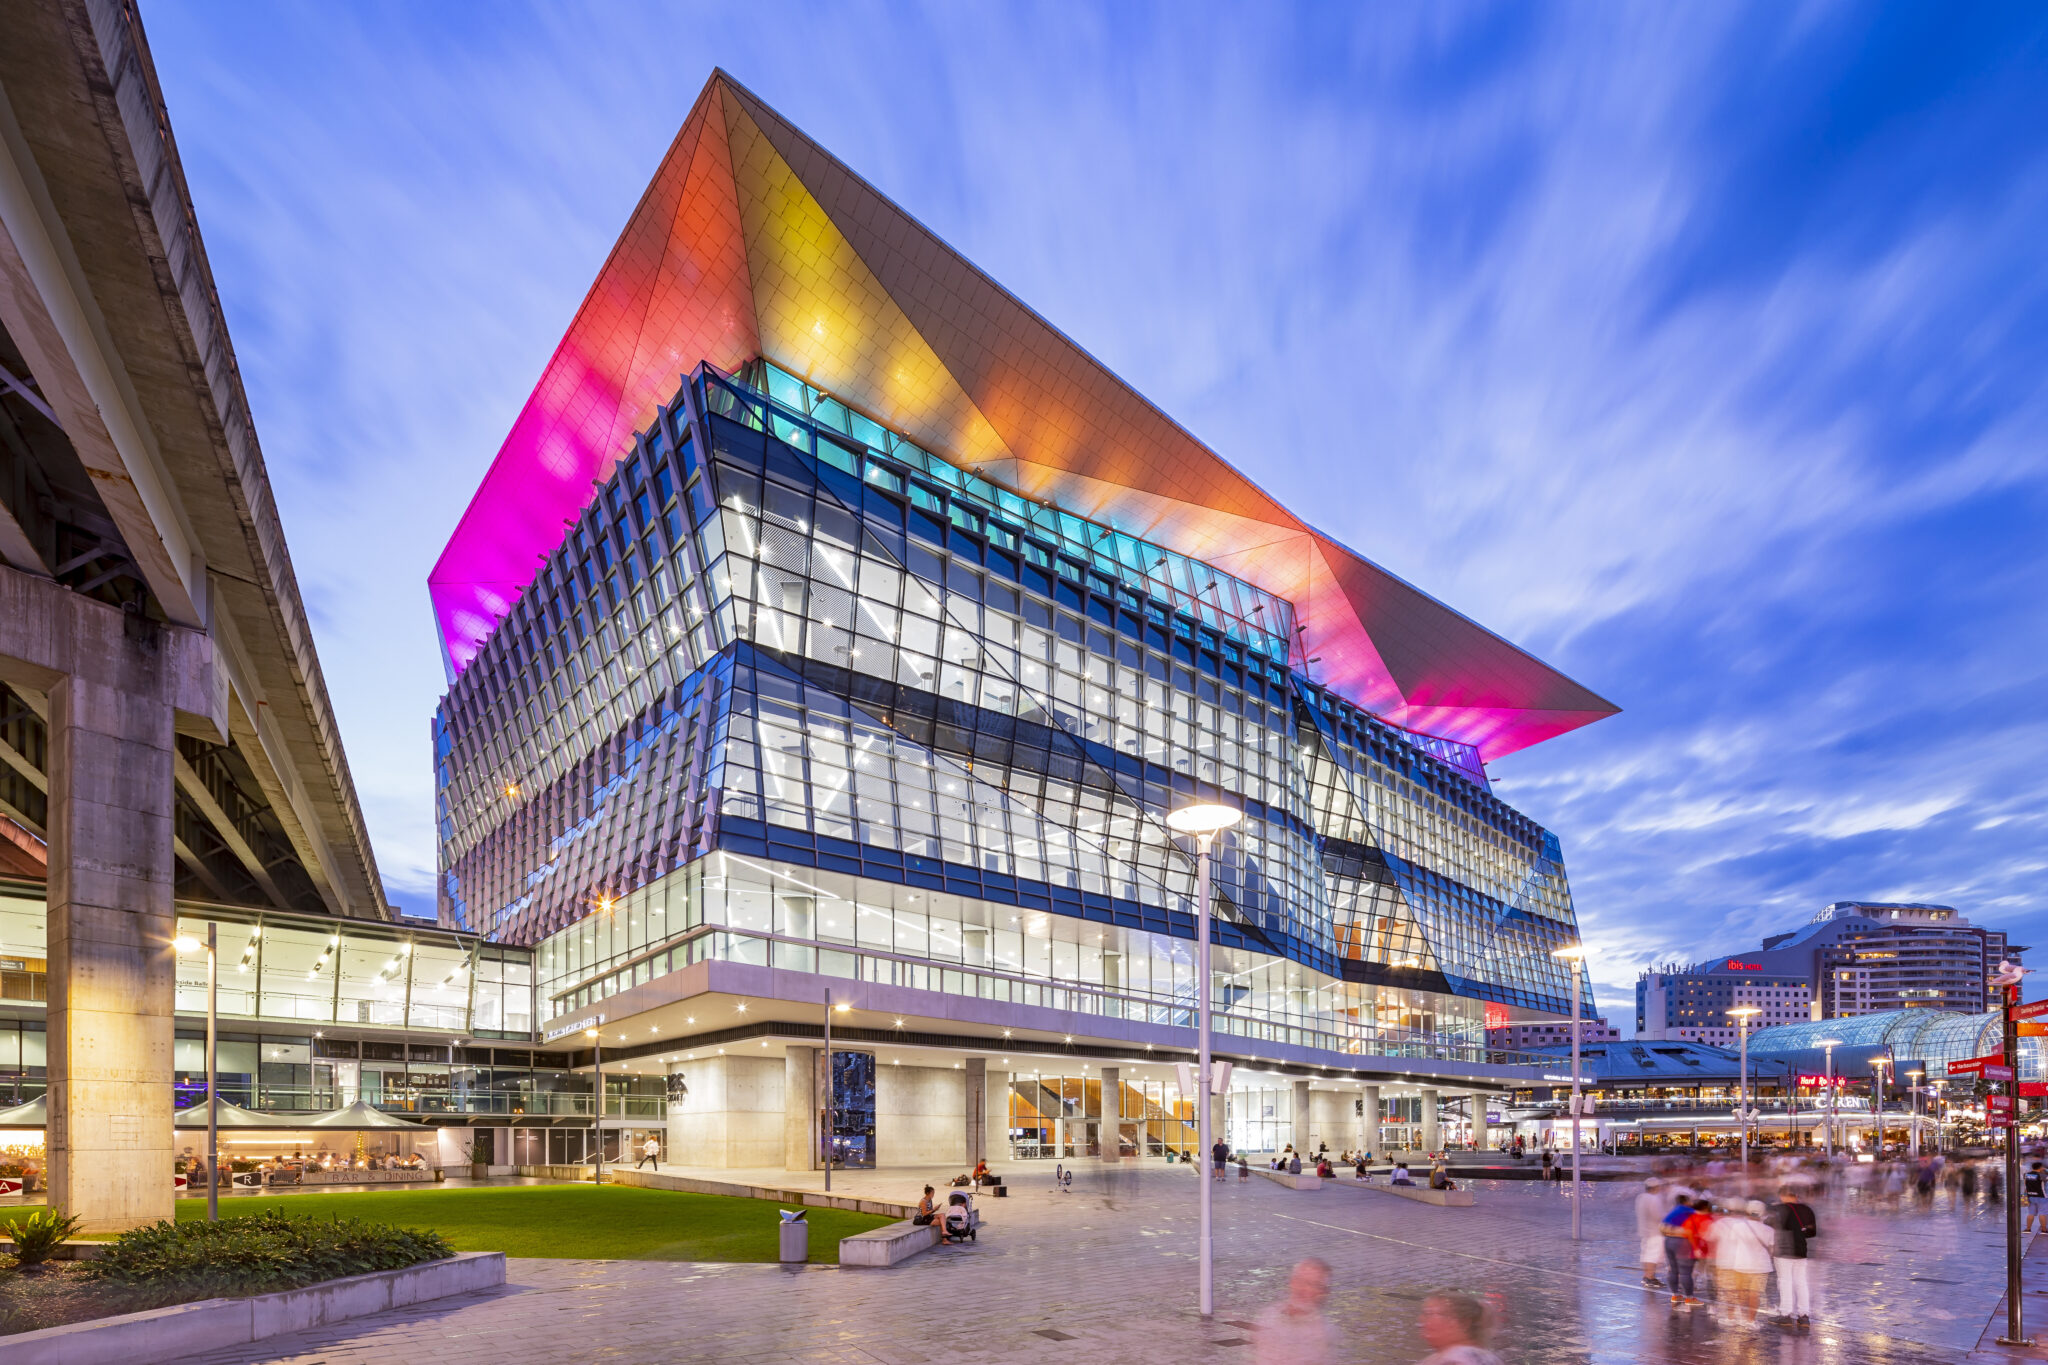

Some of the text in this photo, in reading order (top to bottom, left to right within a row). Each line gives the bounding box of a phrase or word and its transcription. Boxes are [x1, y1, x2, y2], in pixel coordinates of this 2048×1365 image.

[1728, 959, 1743, 970] ibis
[1956, 1061, 1982, 1070] Harbourside
[1800, 1076, 1816, 1085] Hard
[1818, 1076, 1834, 1087] Ro
[243, 1175, 252, 1185] R
[332, 1172, 424, 1182] BAR & DINING
[0, 1181, 11, 1192] A
